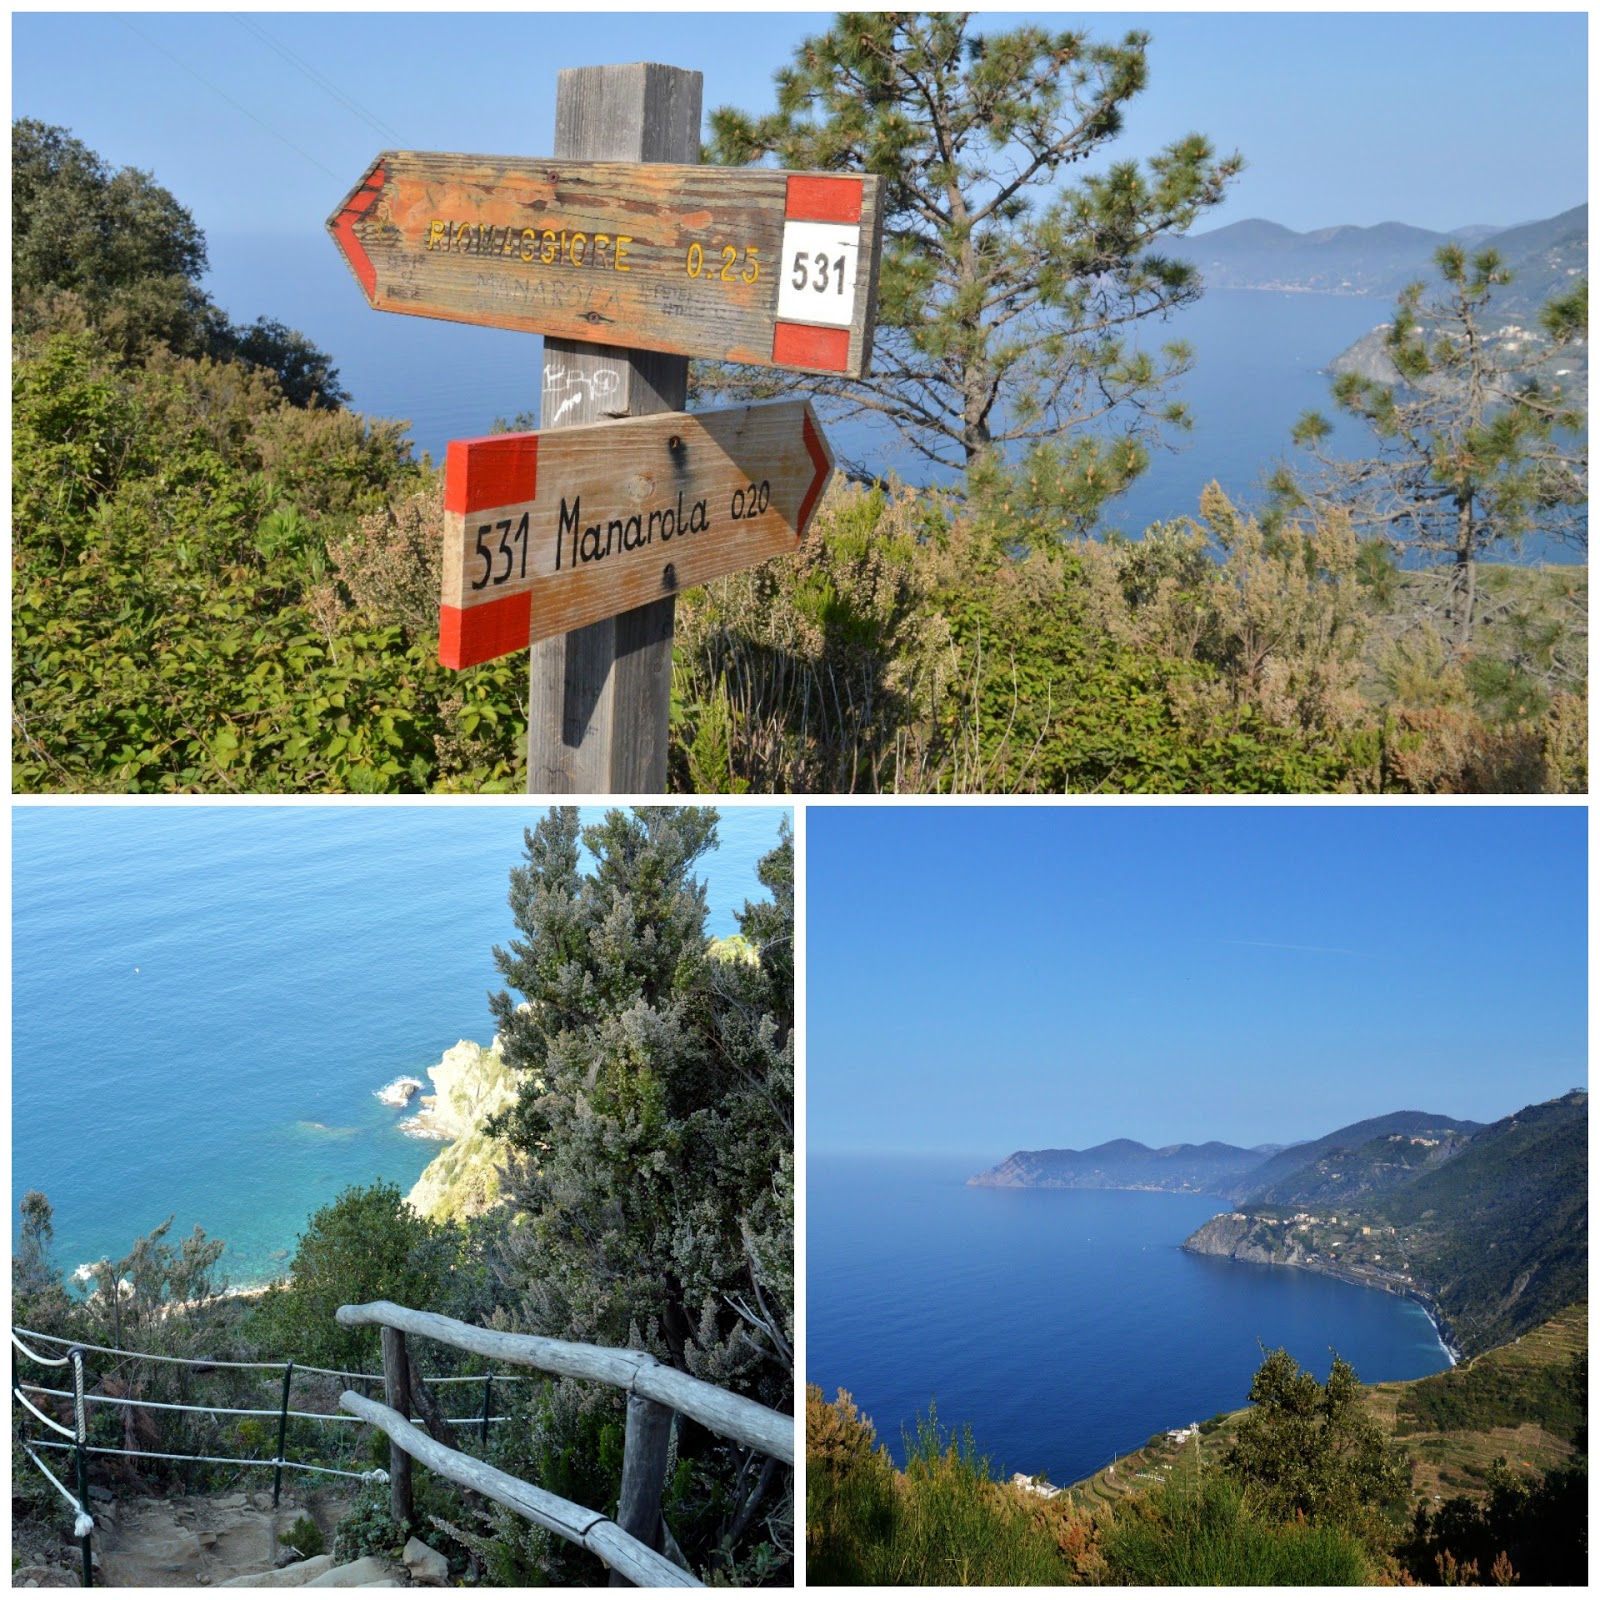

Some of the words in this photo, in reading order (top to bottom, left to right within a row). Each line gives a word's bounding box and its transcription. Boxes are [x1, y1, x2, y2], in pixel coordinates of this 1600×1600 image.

[428, 219, 632, 271] RIOMAGGIORE
[686, 243, 761, 284] 0.25
[791, 251, 847, 296] 531
[472, 511, 529, 590] 531
[556, 491, 710, 571] Manarola
[731, 480, 770, 520] 0.20
